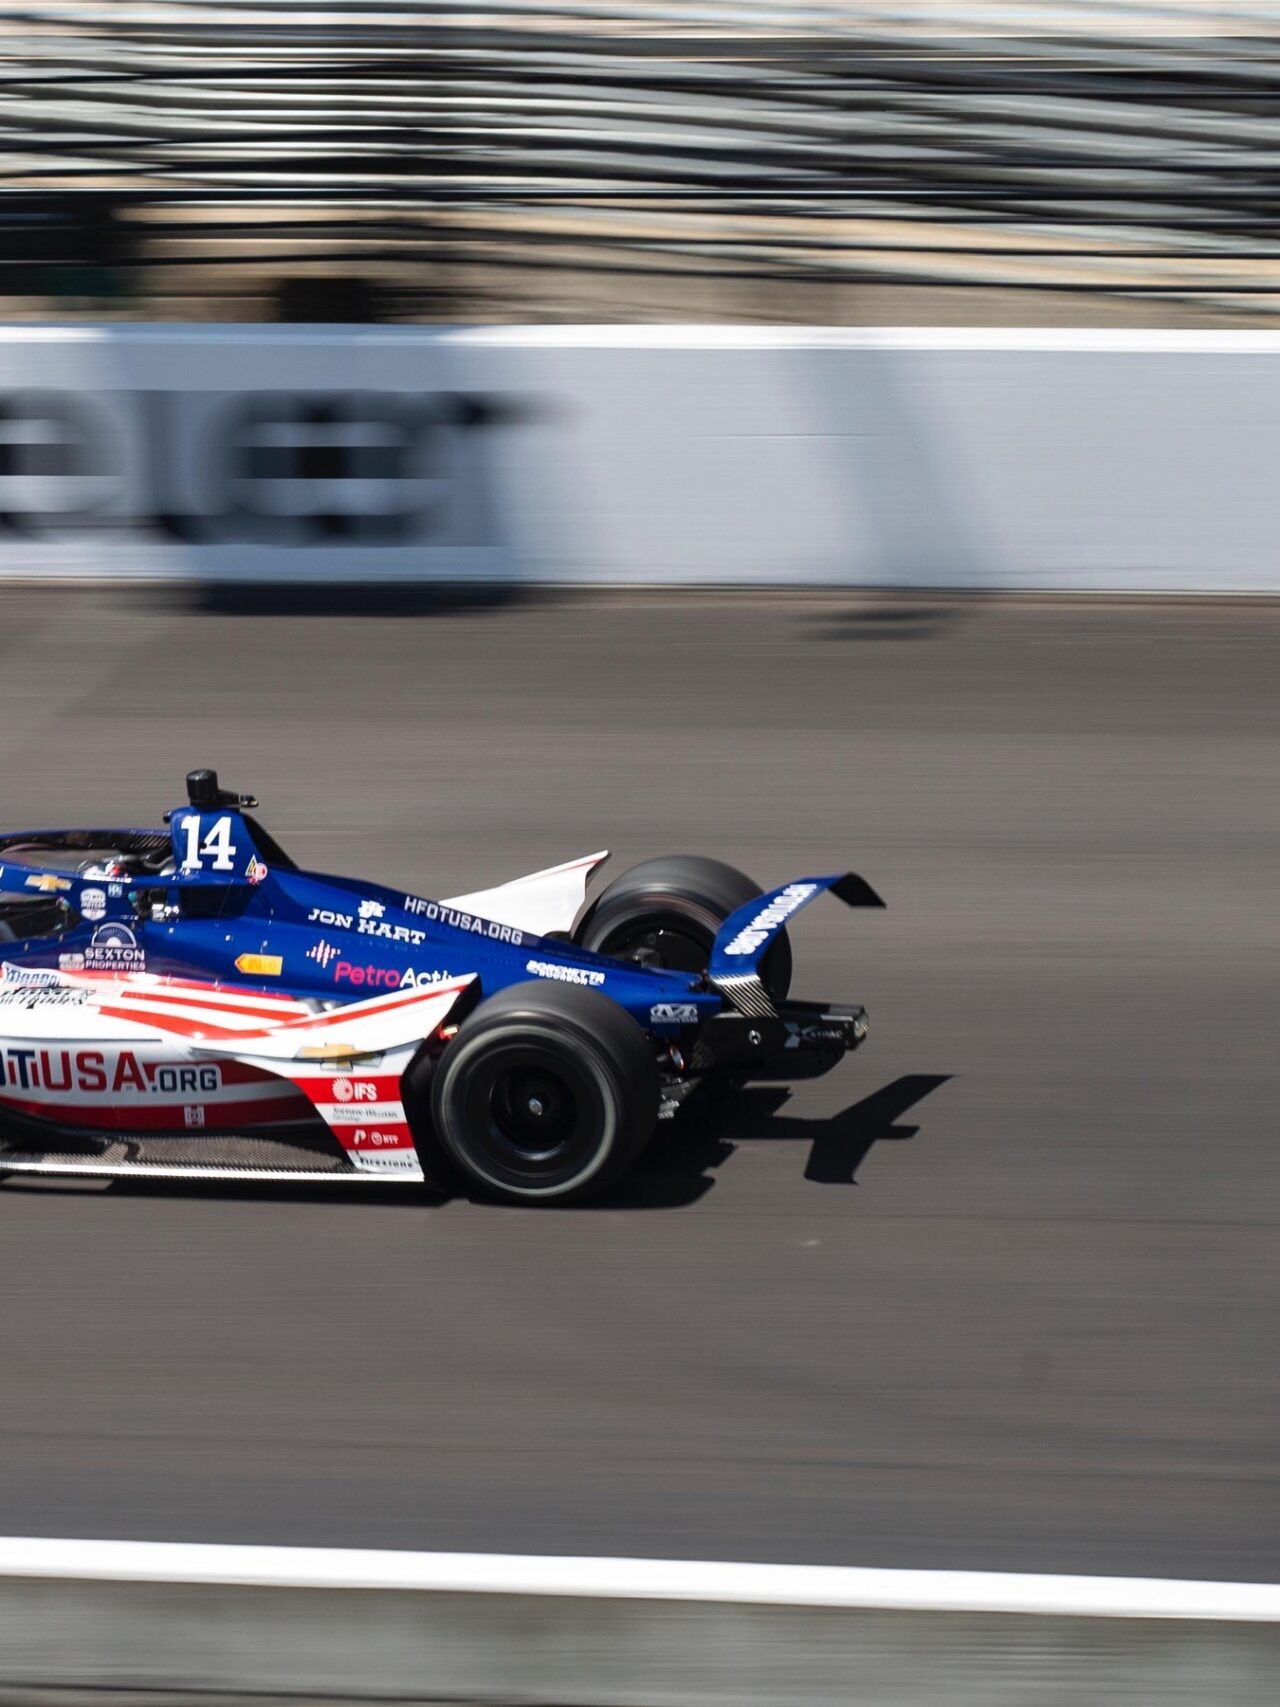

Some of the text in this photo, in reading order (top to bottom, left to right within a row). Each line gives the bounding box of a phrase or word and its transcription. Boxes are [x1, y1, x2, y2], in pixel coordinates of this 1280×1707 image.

[180, 815, 237, 871] 14
[308, 908, 354, 929] JON
[357, 918, 426, 945] HART
[404, 896, 523, 945] HFOTUSA.ORG
[85, 947, 145, 962] SEXTON
[85, 960, 146, 971] PROPERTIES
[353, 1082, 378, 1101] IFS
